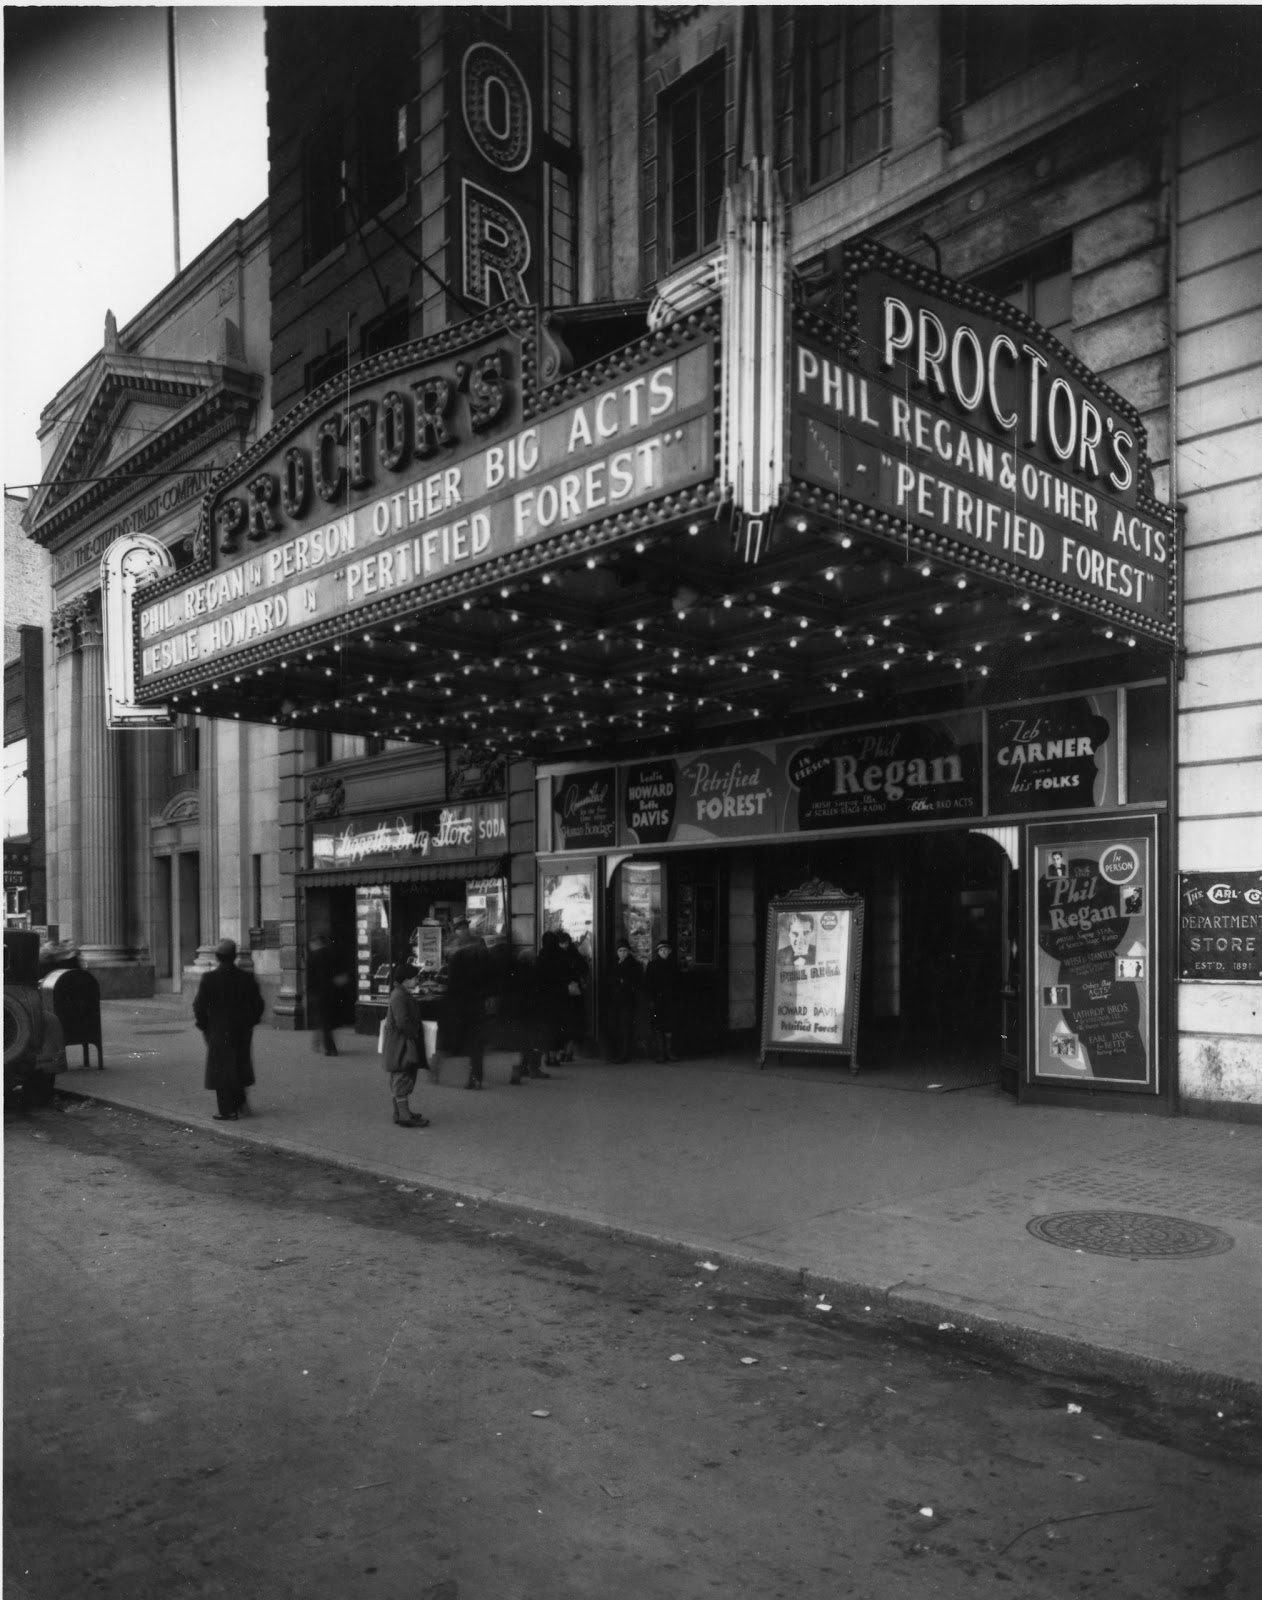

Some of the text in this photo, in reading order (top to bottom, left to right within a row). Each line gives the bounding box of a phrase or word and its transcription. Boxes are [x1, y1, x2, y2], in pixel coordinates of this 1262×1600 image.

[462, 8, 531, 307] OR
[884, 296, 1133, 490] PROCTOR'S
[216, 350, 506, 551] PROCTOR'S
[798, 345, 879, 427] PHIL
[892, 394, 994, 481] REGAN
[1000, 451, 1016, 491] &
[1021, 463, 1098, 531] OTHER
[1112, 510, 1166, 563] ACTS
[76, 542, 92, 567] THE
[131, 496, 161, 532] TRUST
[162, 460, 214, 511] COMPANY
[140, 366, 674, 639] PHIL REGAN IN PERSON OTHER BIG ACTS
[881, 453, 1154, 604] "PETRIFIED FOREST"
[142, 630, 199, 677] LESLIE
[210, 594, 289, 653] HOWARD
[334, 513, 491, 601] "PERTIFIED
[515, 429, 683, 538] FOREST"
[858, 731, 901, 761] Phil
[997, 736, 1095, 766] CARNER
[794, 757, 831, 781] PERSON
[799, 757, 811, 768] IN
[690, 762, 761, 797] Petrified
[832, 754, 964, 801] Regan
[1035, 774, 1080, 790] FOLKS
[629, 782, 674, 801] HOWARD
[697, 787, 772, 820] FOREST"
[936, 800, 951, 810] RKO
[953, 797, 973, 808] ACTS
[479, 818, 506, 840] SODA
[632, 809, 669, 828] DAVIS
[1105, 861, 1134, 873] PERSON
[1046, 876, 1098, 907] Phil
[1183, 887, 1204, 906] THE
[1049, 905, 1118, 931] Regan
[1190, 937, 1256, 952] STORE
[780, 965, 841, 983] PHIL REGA
[1233, 962, 1252, 970] 1891
[778, 1005, 838, 1017] HOWARD DAVIS
[1107, 1002, 1129, 1014] BROS
